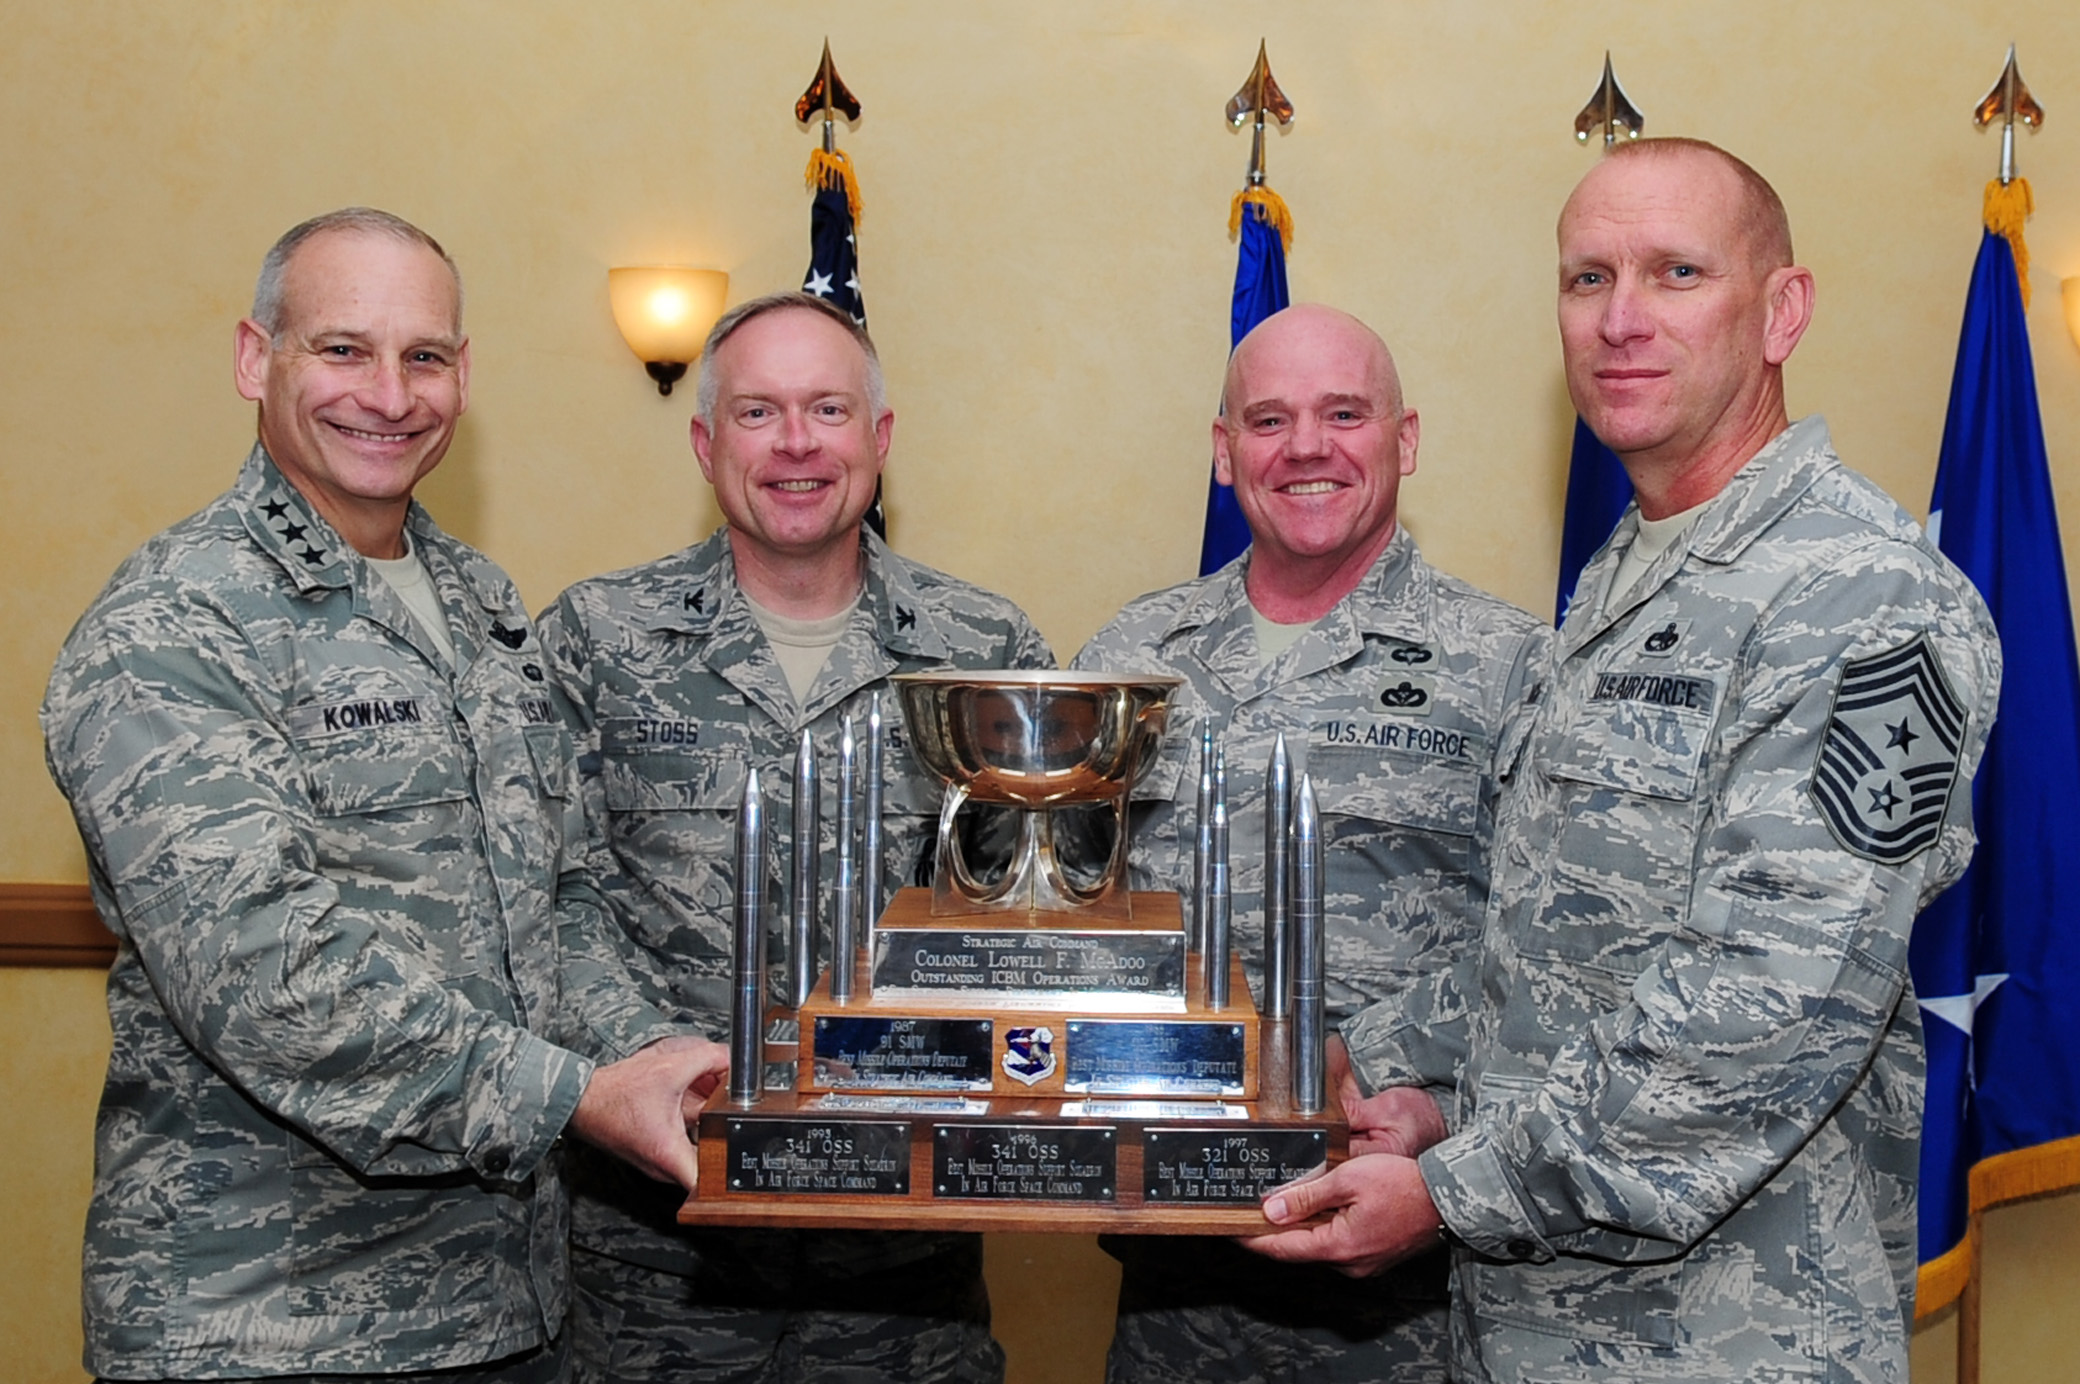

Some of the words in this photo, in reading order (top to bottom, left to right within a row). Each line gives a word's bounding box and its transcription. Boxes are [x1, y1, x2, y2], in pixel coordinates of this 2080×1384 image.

[1613, 675, 1641, 699] AIR
[1636, 676, 1701, 708] FORCE
[324, 700, 421, 731] KOWALSKI
[637, 719, 698, 744] STOSS
[1326, 720, 1361, 745] U.S.
[1364, 723, 1400, 747] AIR
[1406, 727, 1471, 758] FORCE
[962, 936, 1015, 948] STRATEGIC
[1022, 937, 1042, 948] AIR
[1049, 937, 1099, 949] COMMAND
[915, 950, 978, 967] COLONEL
[988, 951, 1045, 968] LOWELL
[1056, 952, 1070, 968] F.
[911, 970, 984, 984] OUTSTANDING
[991, 971, 1026, 985] ICBM
[1033, 972, 1099, 985] OPERATIONS
[1105, 974, 1149, 986] AWARD
[890, 1021, 915, 1032] 1987
[879, 1036, 892, 1049] 91
[786, 1138, 811, 1154] 341
[822, 1139, 853, 1154] OSS
[991, 1144, 1018, 1159] 341
[1027, 1145, 1059, 1159] OSS
[1223, 1138, 1248, 1149] 1997
[1201, 1148, 1228, 1162] 321
[1239, 1148, 1270, 1162] OSS
